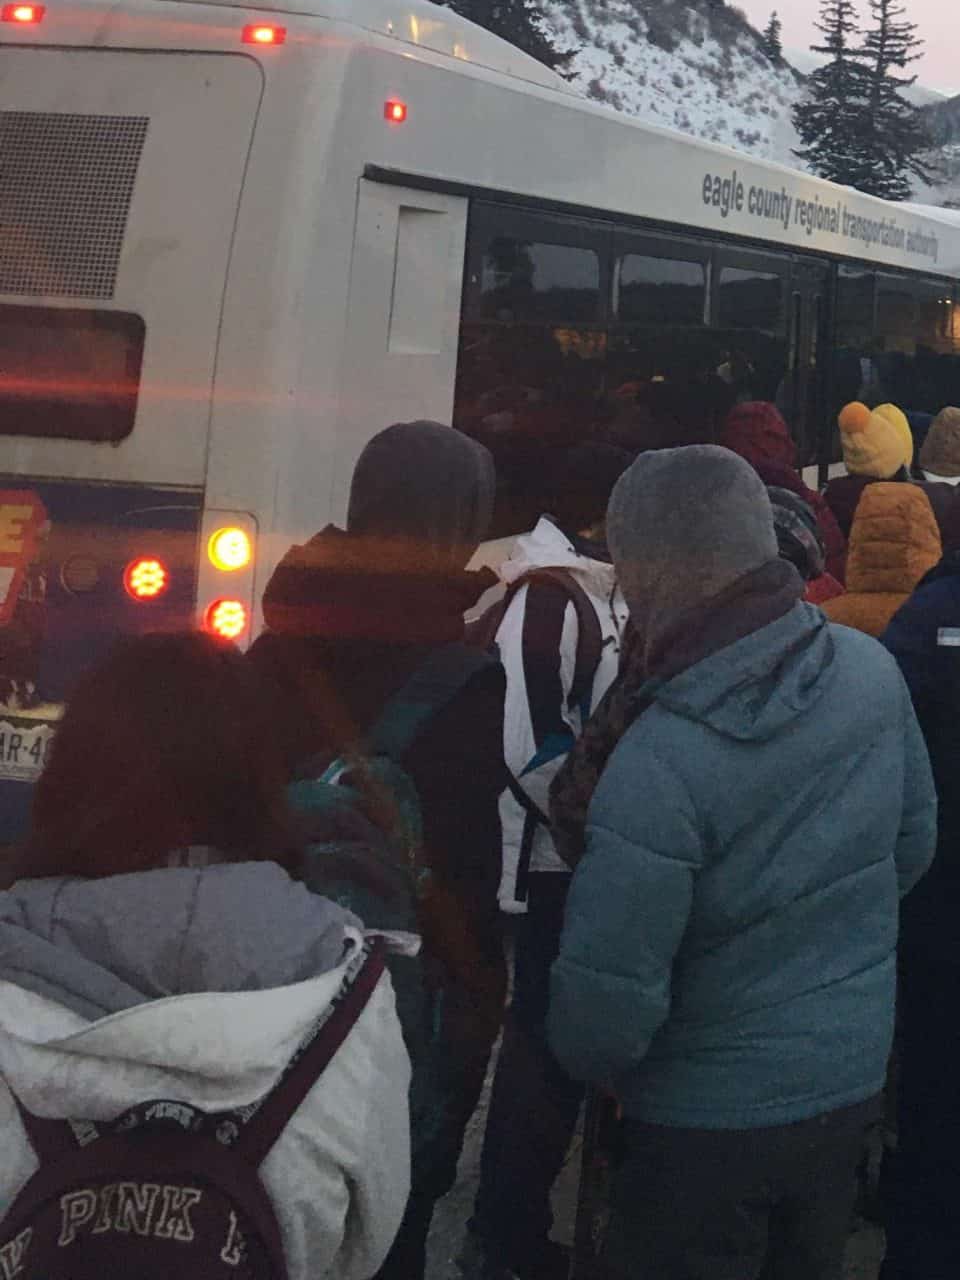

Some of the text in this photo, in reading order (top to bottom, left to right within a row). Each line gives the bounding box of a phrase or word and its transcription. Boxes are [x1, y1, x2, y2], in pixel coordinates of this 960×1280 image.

[702, 170, 744, 218] eagle
[748, 187, 793, 230] county
[794, 194, 841, 235] regional
[58, 1183, 202, 1247] PINK
